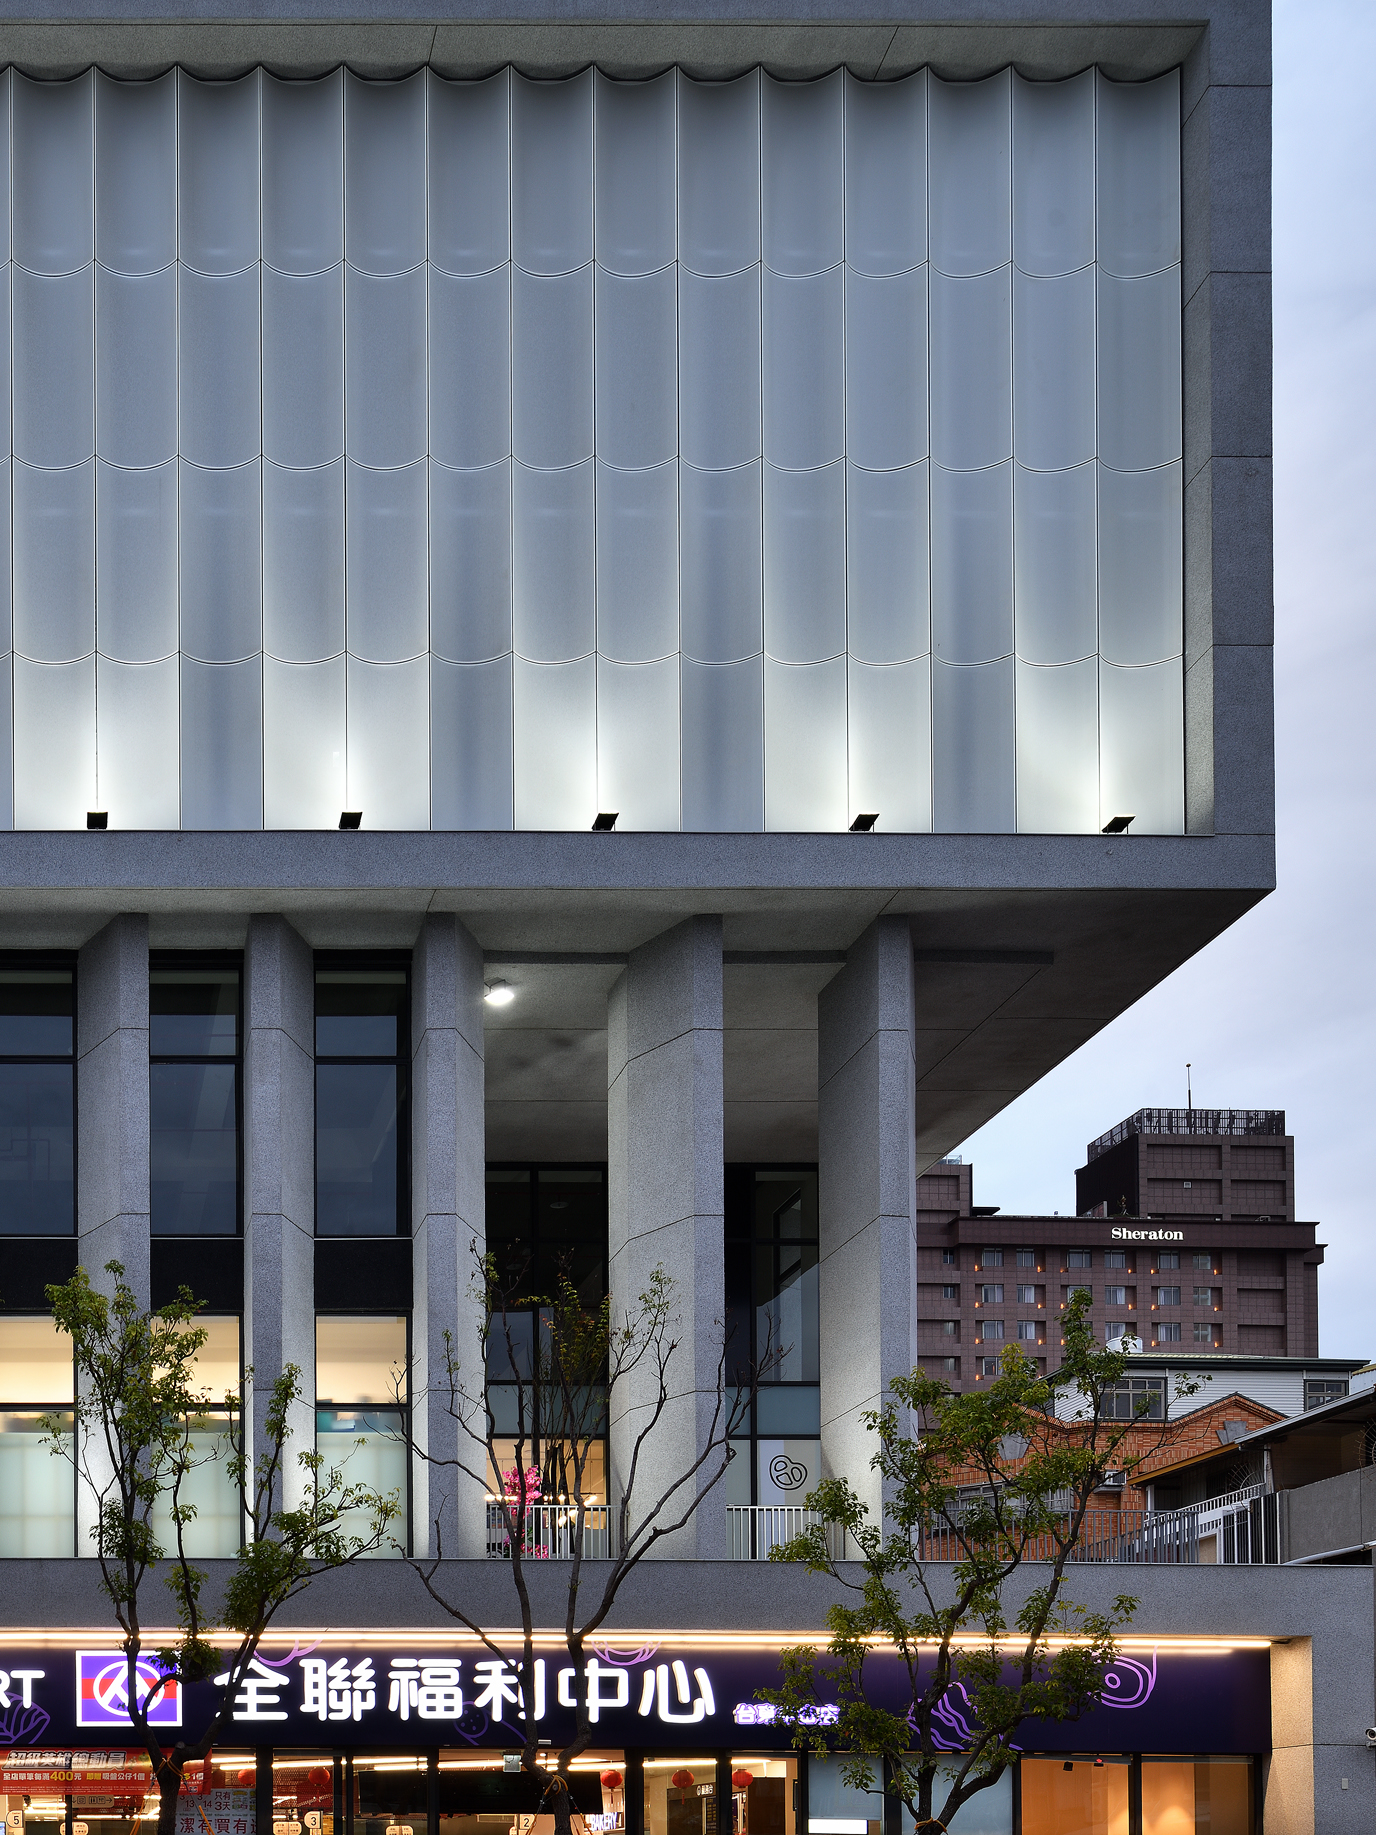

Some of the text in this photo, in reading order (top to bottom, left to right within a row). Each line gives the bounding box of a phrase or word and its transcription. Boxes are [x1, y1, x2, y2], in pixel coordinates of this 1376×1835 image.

[1111, 1227, 1184, 1240] Sheraton
[214, 1657, 716, 1725] 全聯福利中心
[13, 1816, 20, 1825] 5
[310, 1816, 317, 1826] 3
[523, 1817, 530, 1827] 2
[590, 1812, 618, 1831] BAKERY
